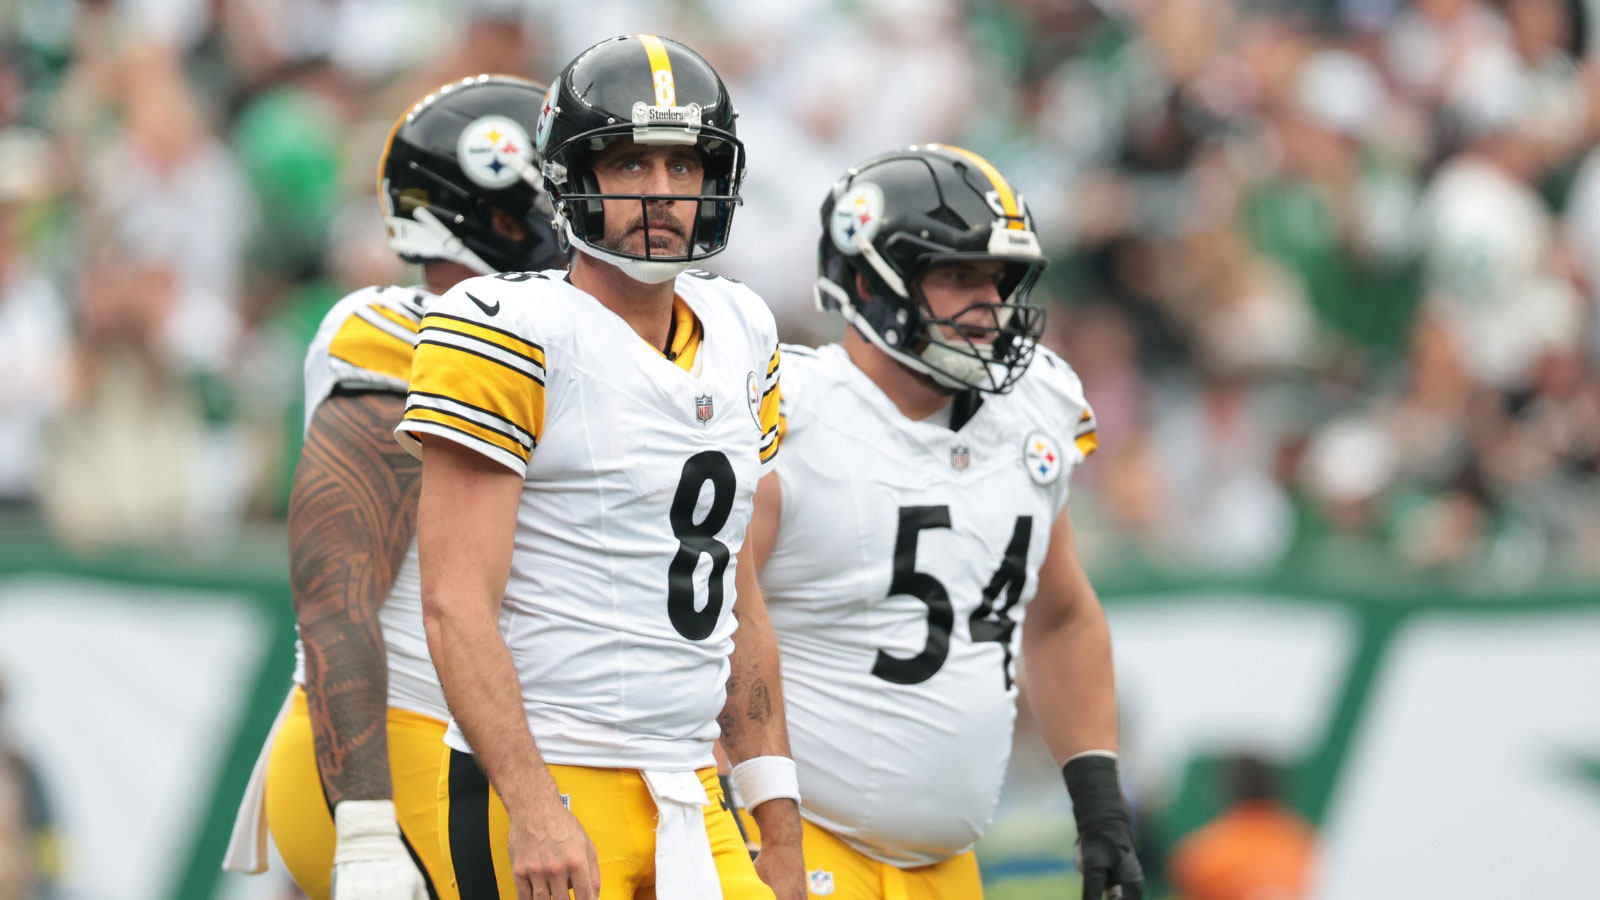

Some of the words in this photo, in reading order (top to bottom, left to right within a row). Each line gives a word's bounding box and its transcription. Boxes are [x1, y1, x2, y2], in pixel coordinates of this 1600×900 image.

[649, 108, 684, 120] Steelers
[654, 69, 675, 105] 8
[668, 450, 736, 640] 8
[871, 505, 1033, 691] 54
